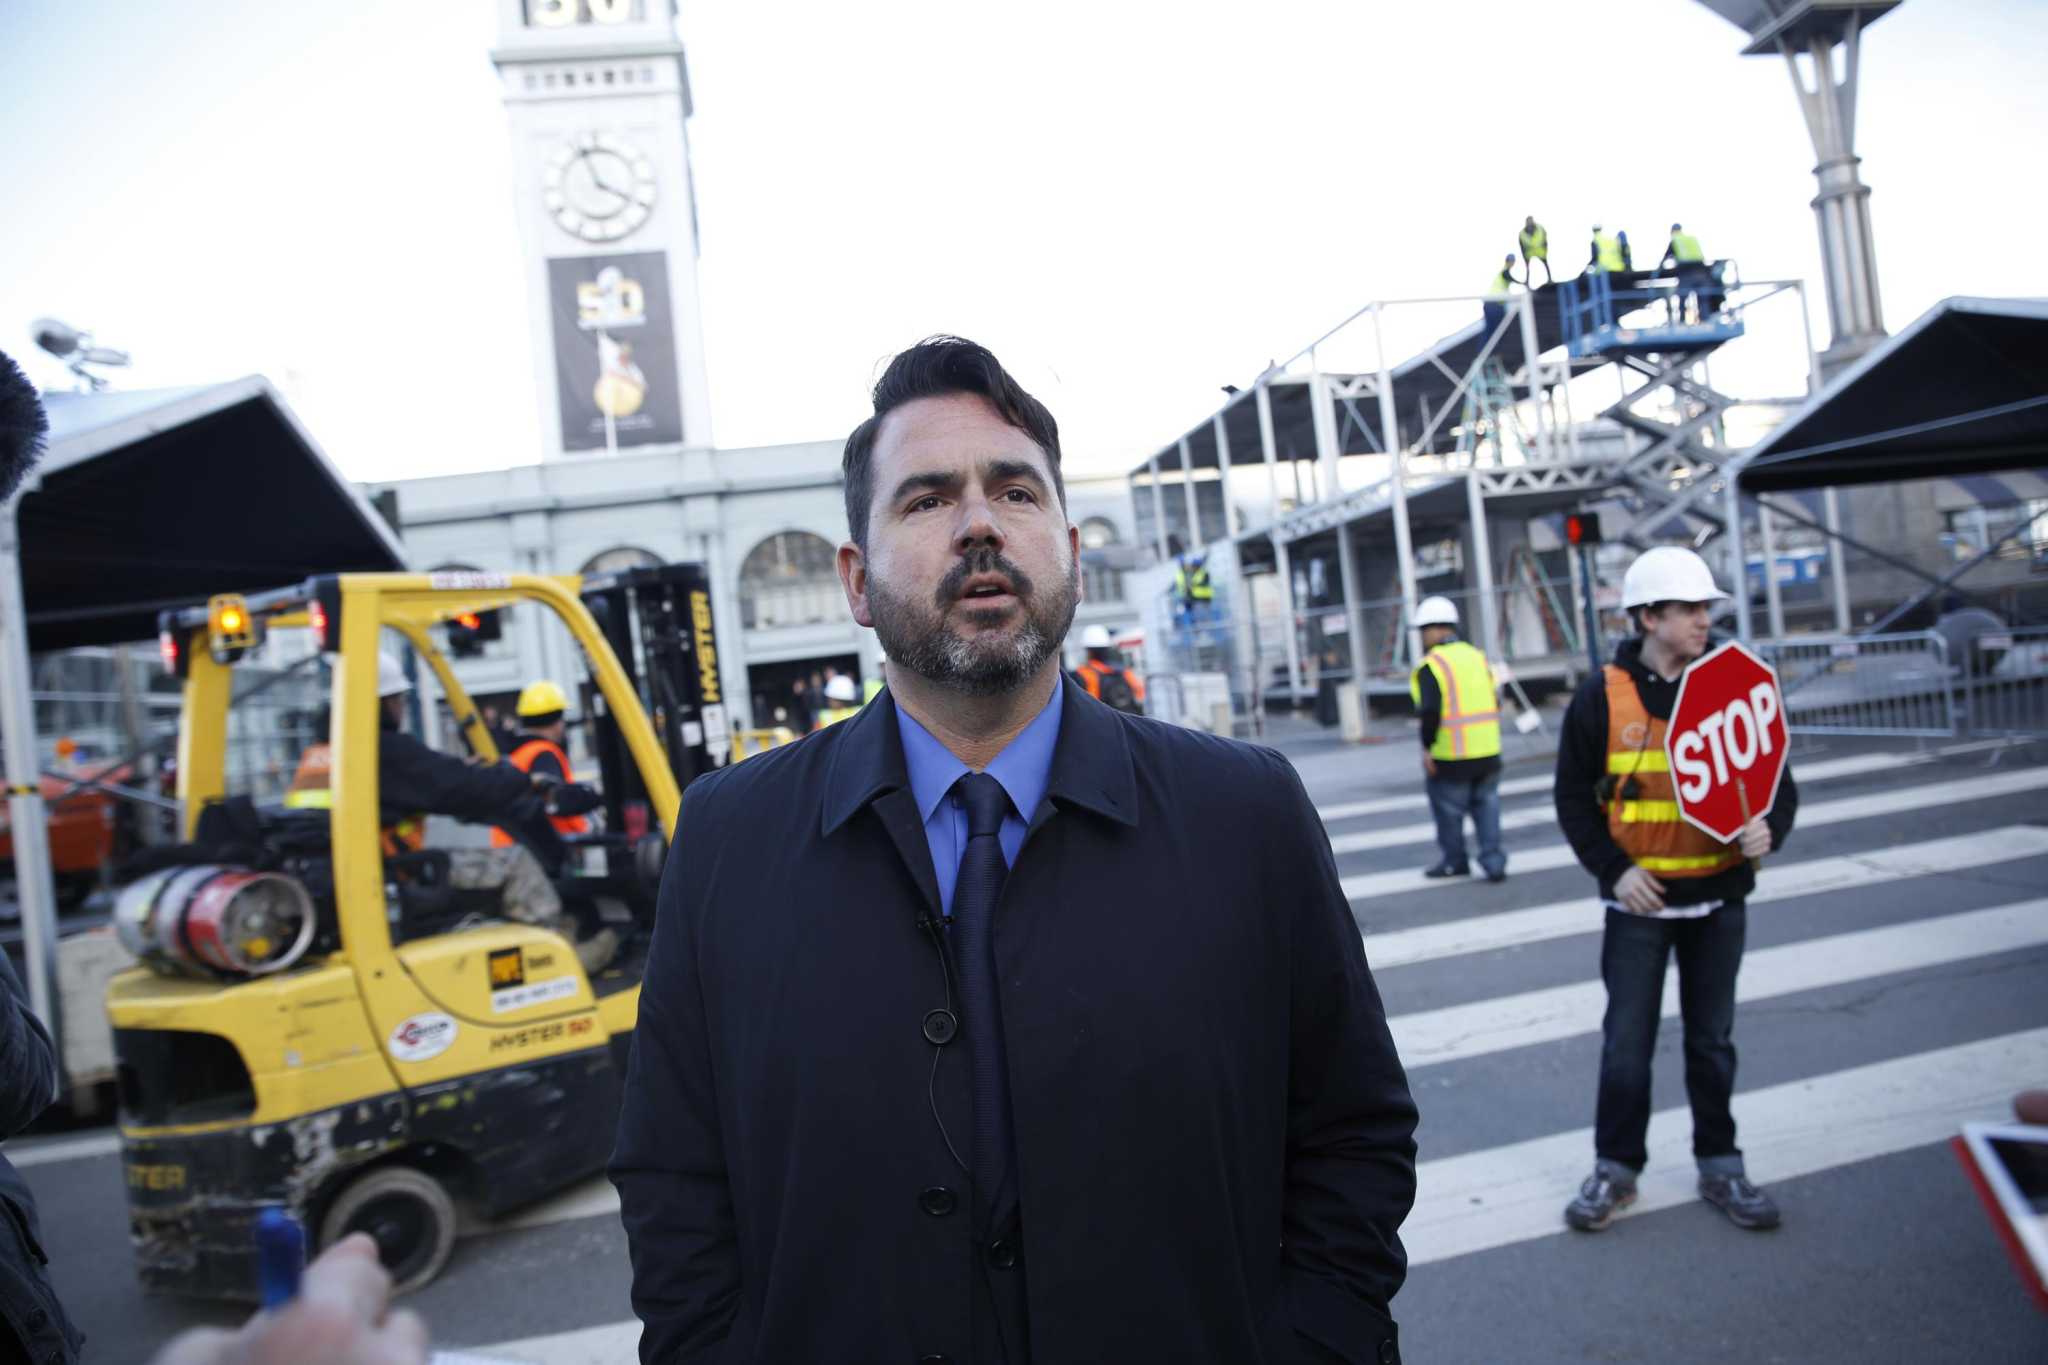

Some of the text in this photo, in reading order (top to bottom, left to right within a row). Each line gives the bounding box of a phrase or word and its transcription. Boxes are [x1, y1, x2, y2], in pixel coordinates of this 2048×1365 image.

[690, 591, 720, 702] HYSTER
[1674, 682, 1777, 803] STOP
[490, 1024, 563, 1050] HYSTER
